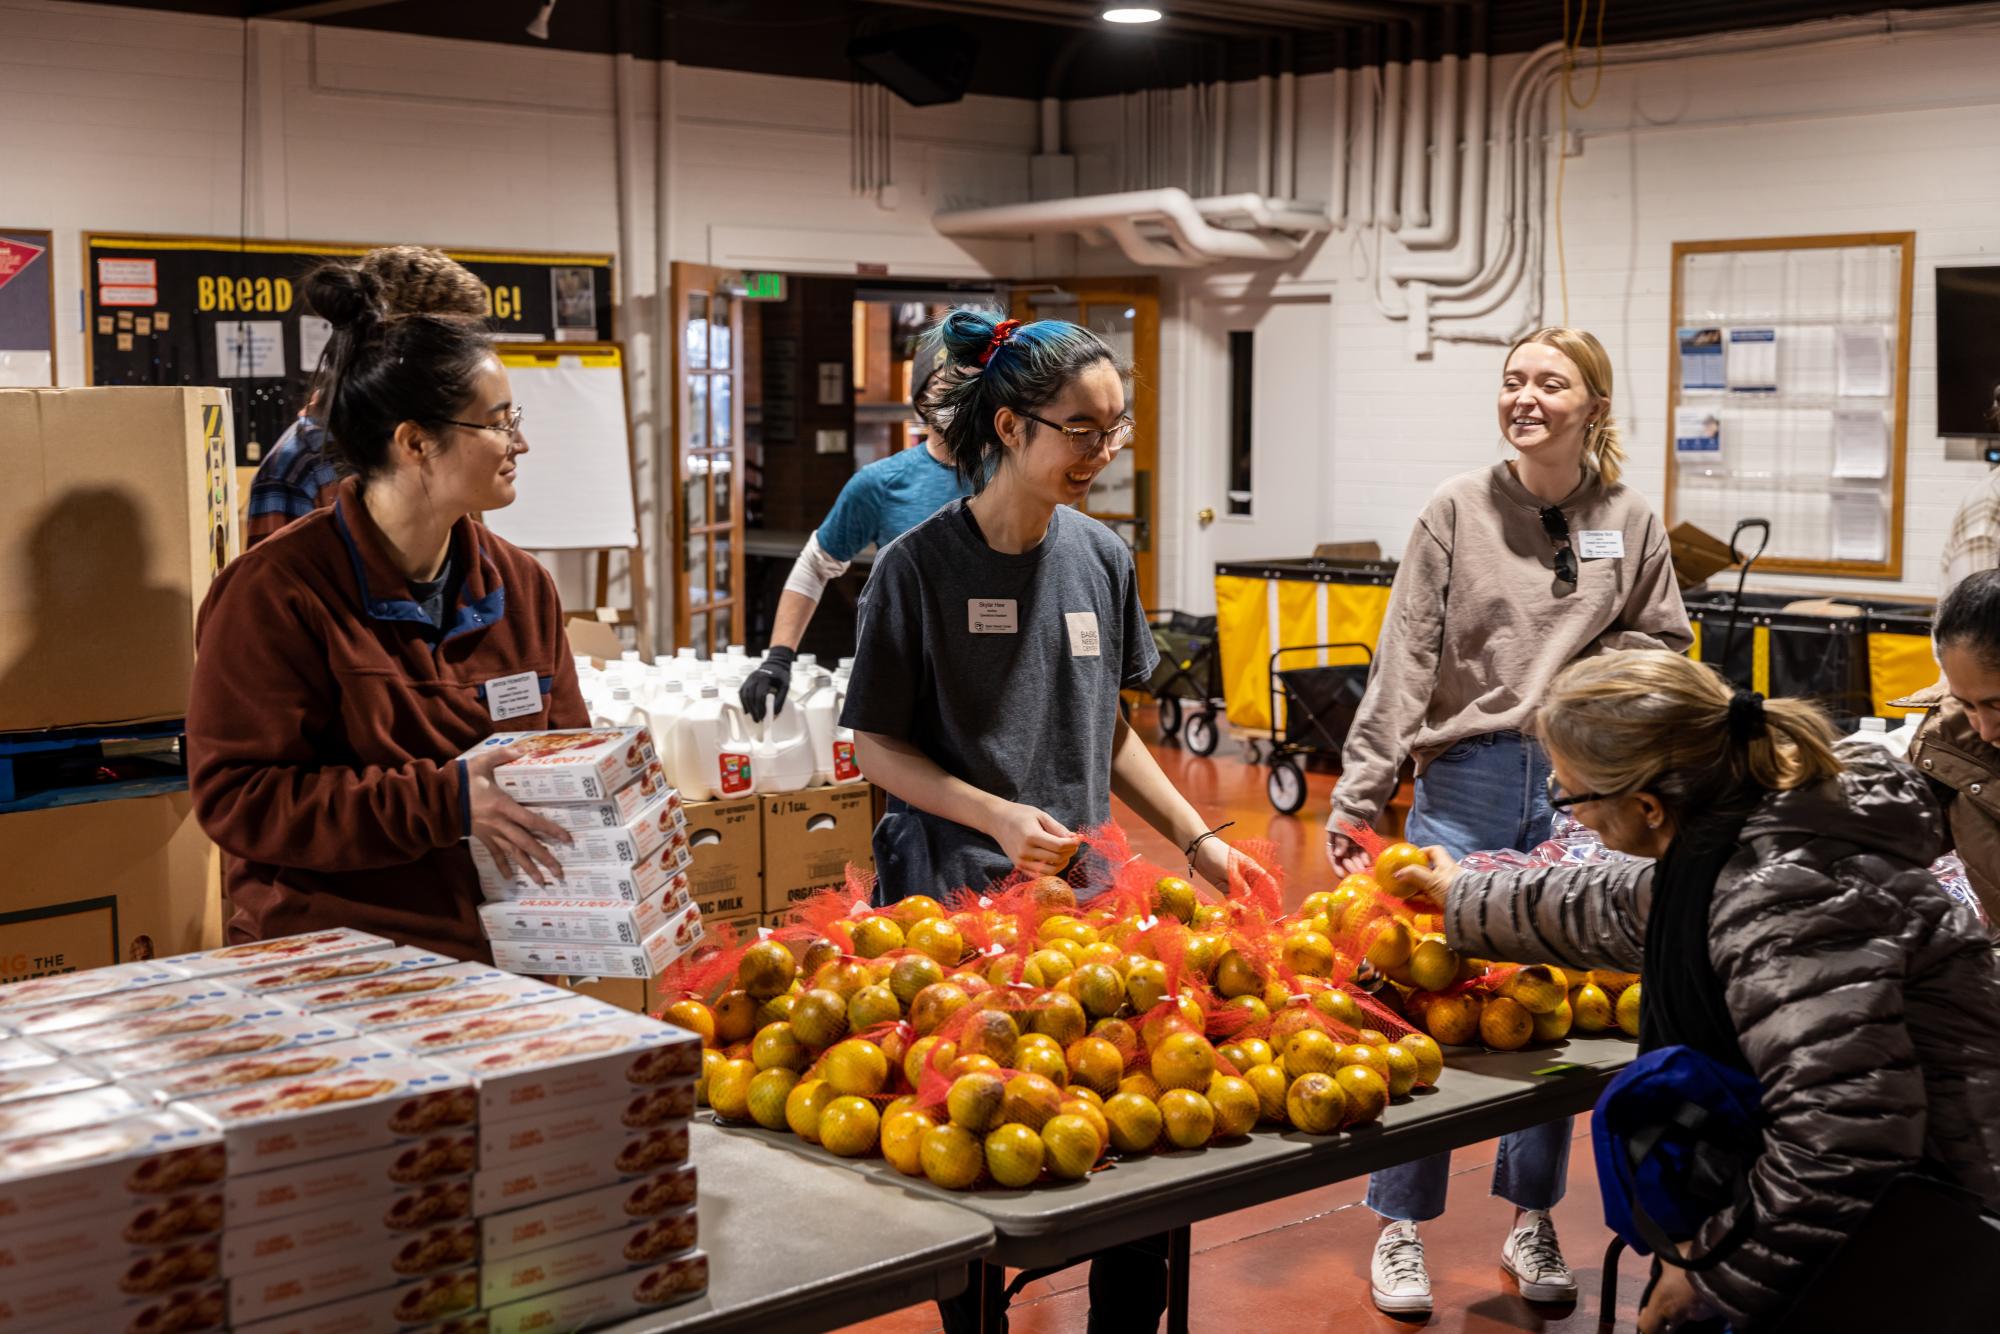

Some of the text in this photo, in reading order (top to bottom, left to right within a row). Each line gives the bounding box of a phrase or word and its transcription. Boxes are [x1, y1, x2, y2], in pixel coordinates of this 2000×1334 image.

[771, 802, 778, 815] 4
[698, 896, 743, 915] NIC MILK
[33, 954, 65, 970] THE
